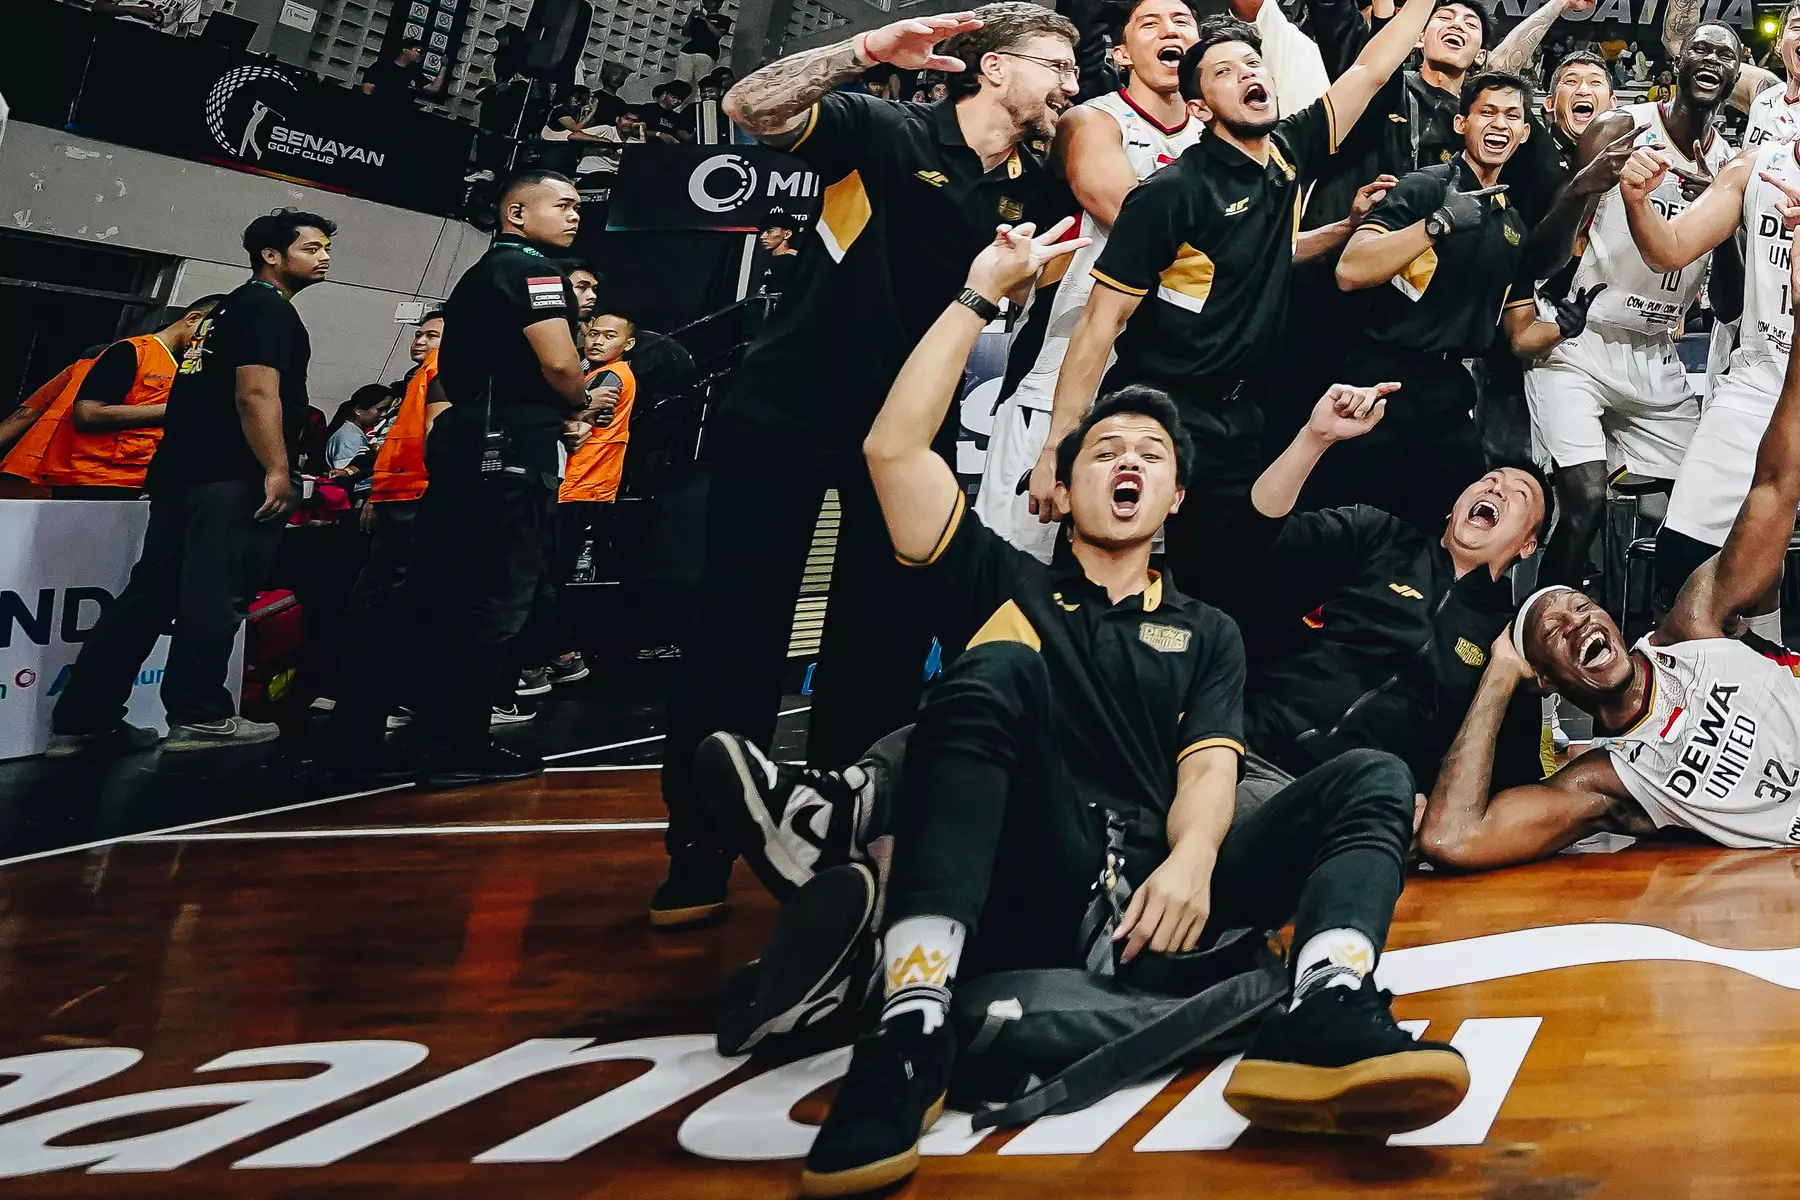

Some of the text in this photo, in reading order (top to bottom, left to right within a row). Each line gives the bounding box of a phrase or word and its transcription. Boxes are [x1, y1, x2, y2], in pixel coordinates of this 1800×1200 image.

[268, 141, 334, 165] GOLF CLUB
[271, 126, 385, 167] SENAYAN
[767, 171, 820, 198] MI
[1660, 269, 1682, 292] 10
[1626, 296, 1643, 310] COW
[1647, 300, 1661, 312] PLAY
[1663, 303, 1677, 314] COW
[1781, 284, 1794, 315] 1
[1774, 325, 1786, 340] PLAY
[1666, 682, 1740, 798] DEWA
[1705, 714, 1756, 799] UNITED
[1754, 758, 1800, 803] 32
